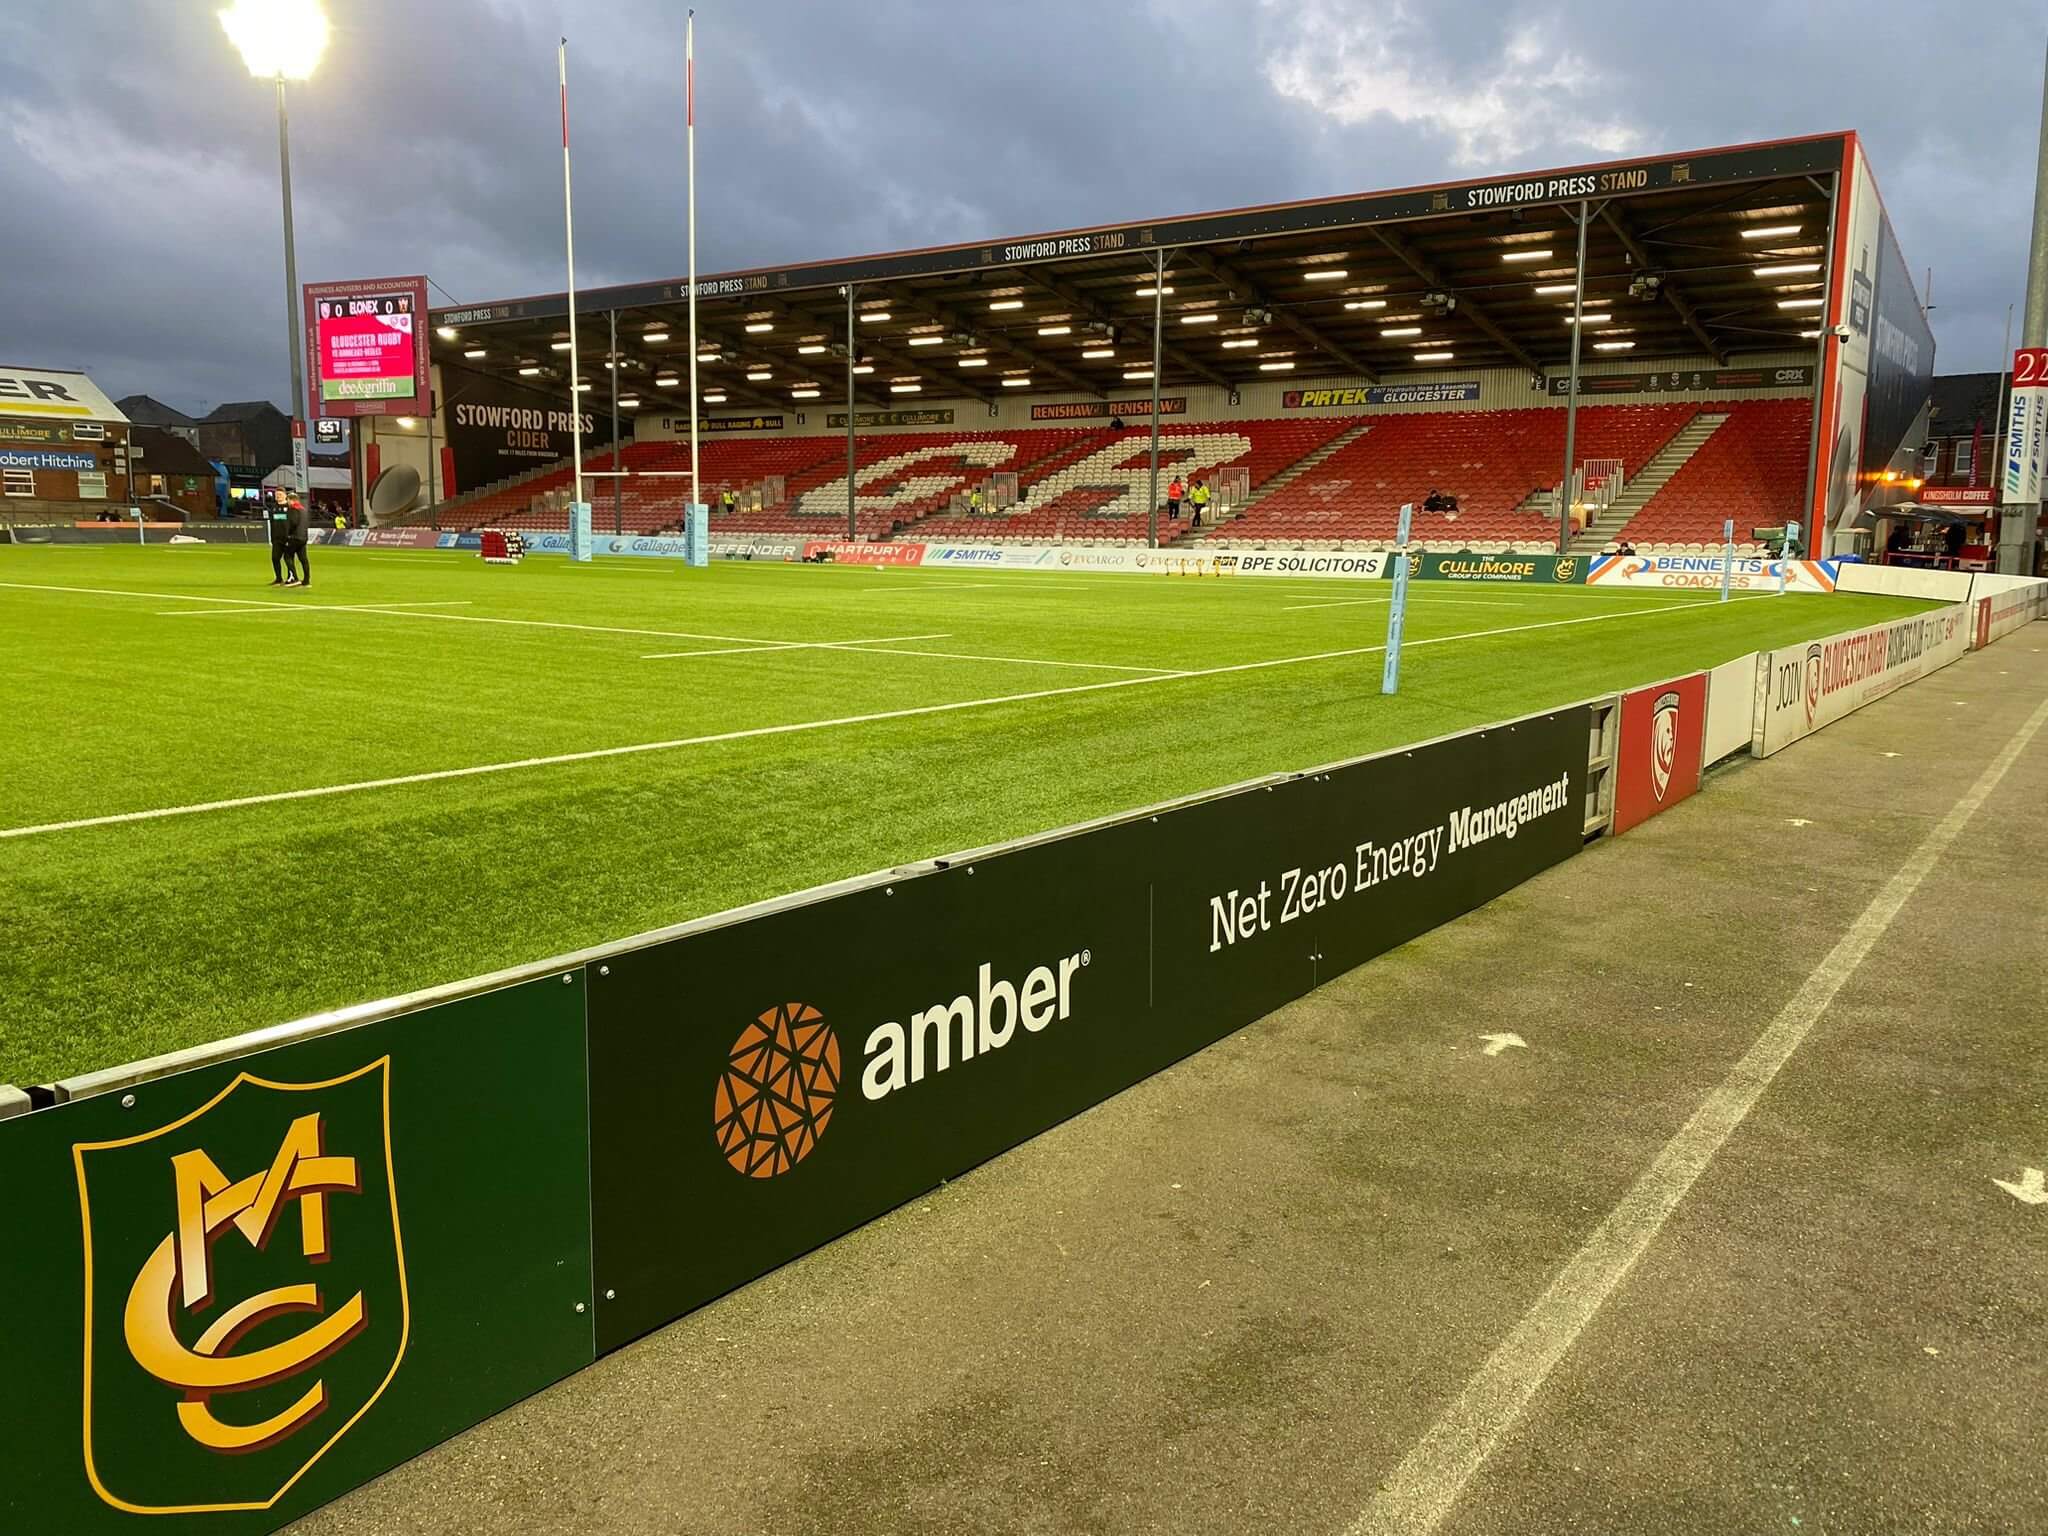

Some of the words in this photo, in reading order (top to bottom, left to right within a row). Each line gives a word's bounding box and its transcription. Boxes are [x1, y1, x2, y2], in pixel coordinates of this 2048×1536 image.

[1467, 183, 1544, 207] STOWFORD
[1549, 175, 1596, 198] PRESS
[1600, 169, 1647, 191] STAND
[1005, 242, 1056, 261] STOWFORD
[1059, 237, 1090, 255] PRESS
[1093, 232, 1125, 250] STAND
[680, 281, 718, 297] STWFORD
[720, 279, 743, 293] PRESS
[744, 276, 767, 290] STAND
[335, 304, 343, 317] 0
[349, 300, 379, 315] ELONEX
[385, 300, 394, 314] 0
[331, 335, 377, 349] GLOUCESTER
[377, 333, 402, 347] RUGBY
[1301, 388, 1370, 407] PIRTEK
[1383, 390, 1466, 403] GLOUCESTER
[1033, 403, 1094, 418] RENISHAW
[1109, 400, 1173, 414] RENISHW
[456, 403, 543, 430] STOWFORD
[548, 411, 594, 434] PRESS
[2009, 396, 2026, 458] SMITHS
[2033, 395, 2044, 457] SMITHS
[507, 430, 549, 449] CIDER
[42, 454, 95, 469] Hitchins
[1923, 490, 1962, 500] KINGSHOLM
[1963, 490, 1991, 500] COFFEE
[632, 538, 686, 554] Gallaghe
[825, 544, 904, 555] HARTPURY
[954, 549, 1003, 561] SMITHS
[1242, 556, 1274, 571] BPE
[1277, 557, 1378, 573] SOLICITORS
[1438, 559, 1536, 576] CULLIMORE
[1662, 574, 1750, 588] COACHES
[1776, 660, 1803, 712] JOIN
[1823, 634, 1868, 696] GLOUCESTER
[1866, 629, 1889, 678] RUGBY
[1210, 880, 1271, 953] Net
[1281, 863, 1347, 923] Zero
[1354, 825, 1444, 893] Energy
[1448, 771, 1569, 854] Management
